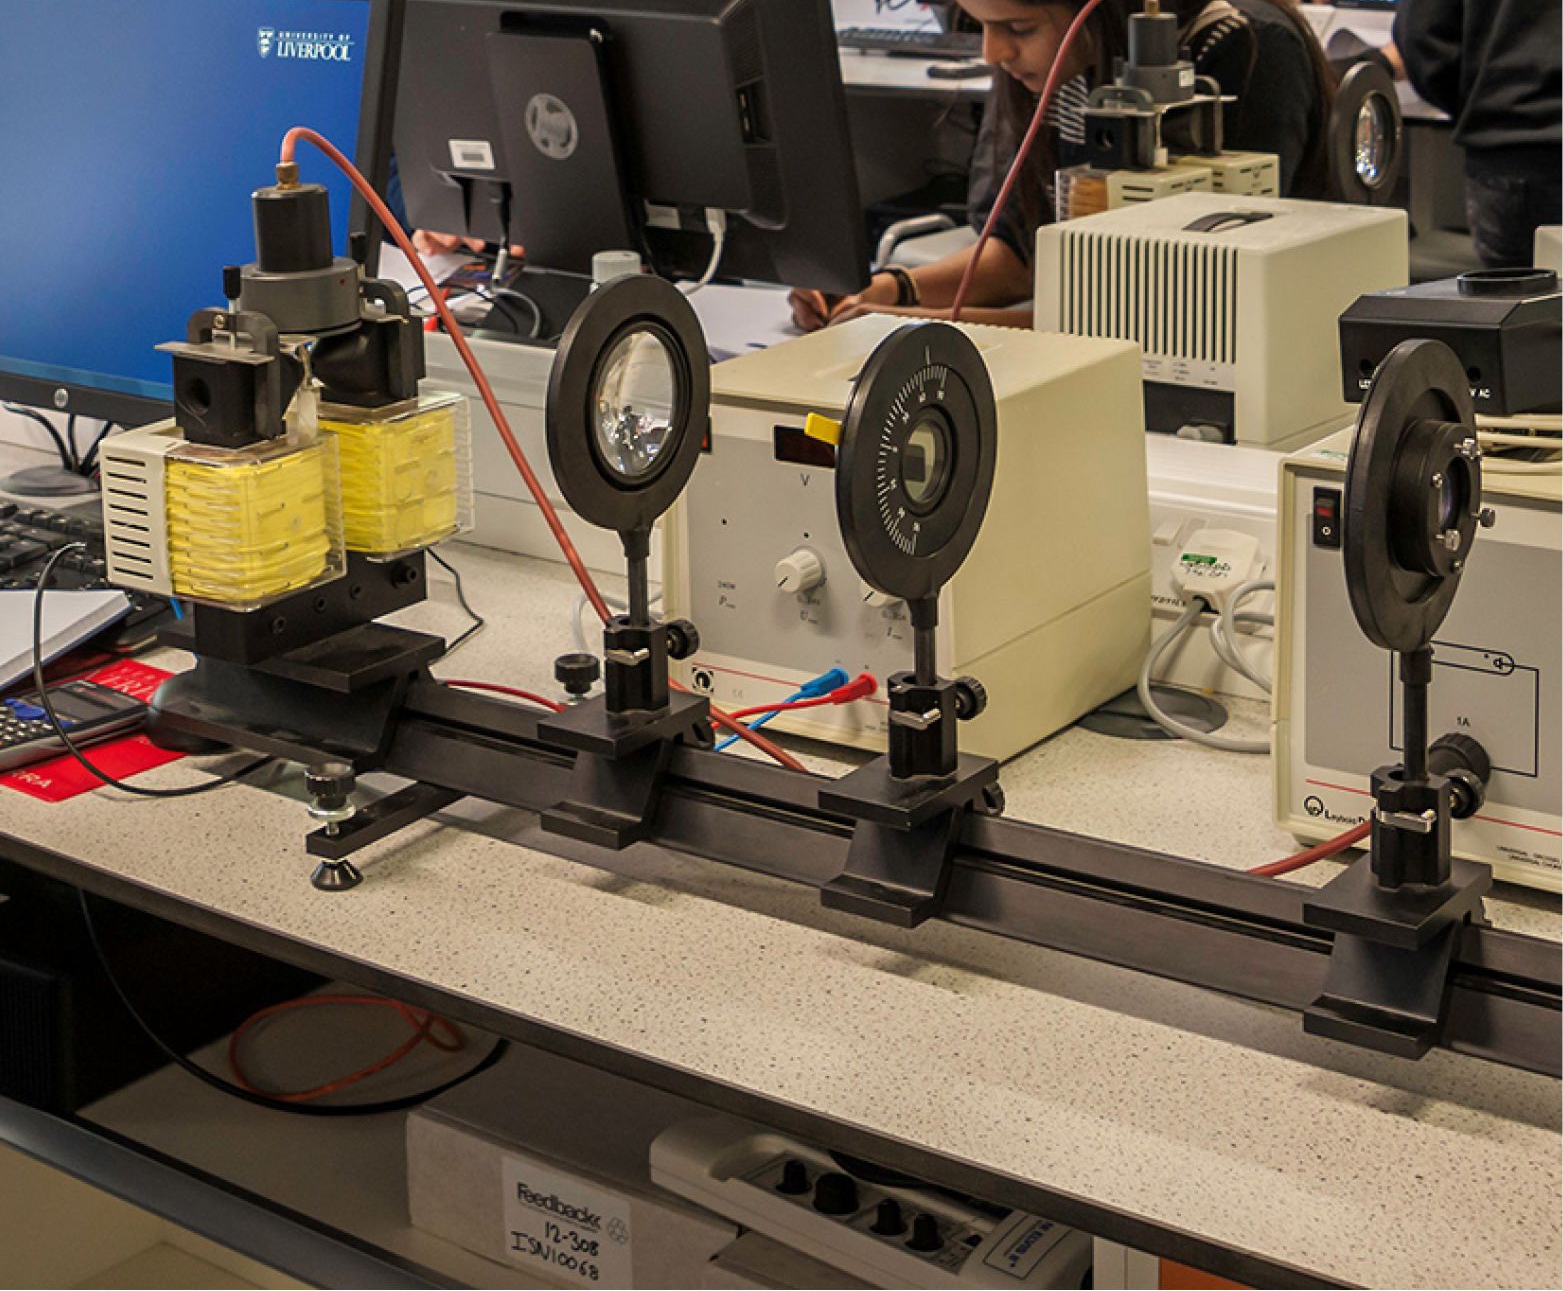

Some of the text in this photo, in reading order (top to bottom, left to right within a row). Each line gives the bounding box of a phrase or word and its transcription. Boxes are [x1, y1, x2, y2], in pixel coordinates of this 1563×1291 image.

[277, 40, 351, 62] LIVERPOOL
[1456, 716, 1471, 728] 1A
[545, 1221, 599, 1257] 12-308
